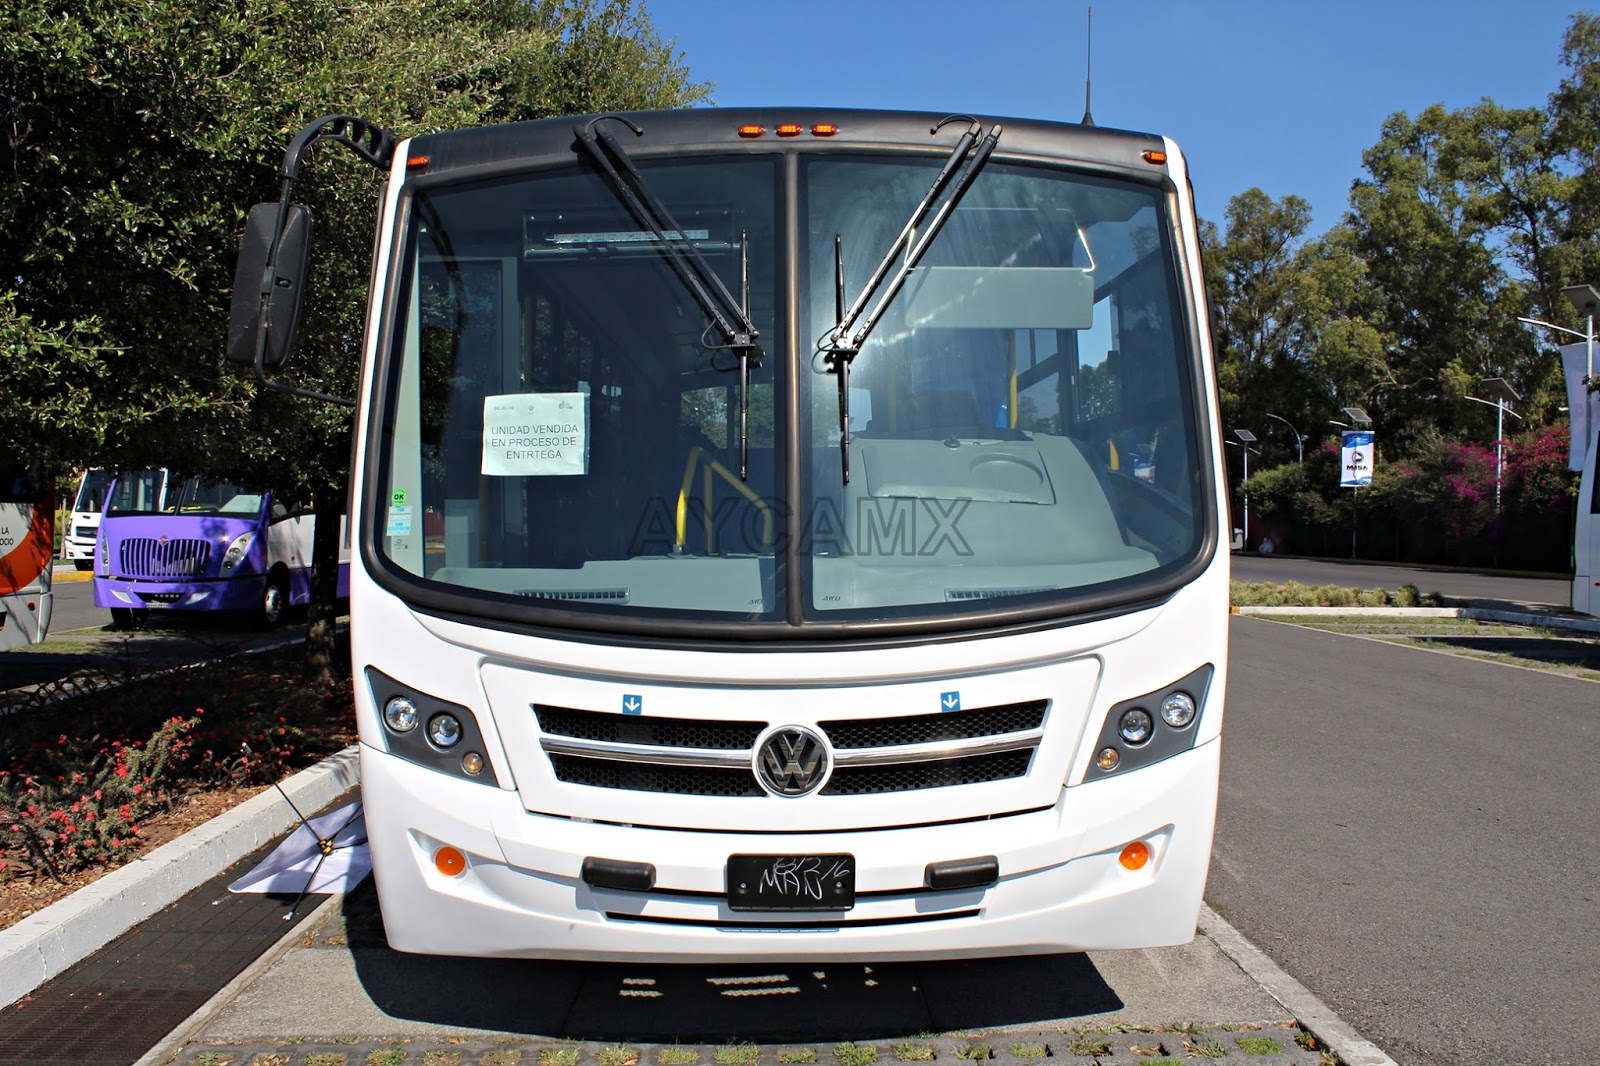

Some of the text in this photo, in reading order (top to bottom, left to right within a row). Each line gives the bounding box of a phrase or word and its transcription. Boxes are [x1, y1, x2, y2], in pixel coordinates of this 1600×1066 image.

[491, 424, 578, 435] UNIDAD VENDIDA
[491, 437, 577, 447] EN PROCESO DE
[506, 450, 562, 460] ENTRTEGA
[2, 527, 9, 535] LA
